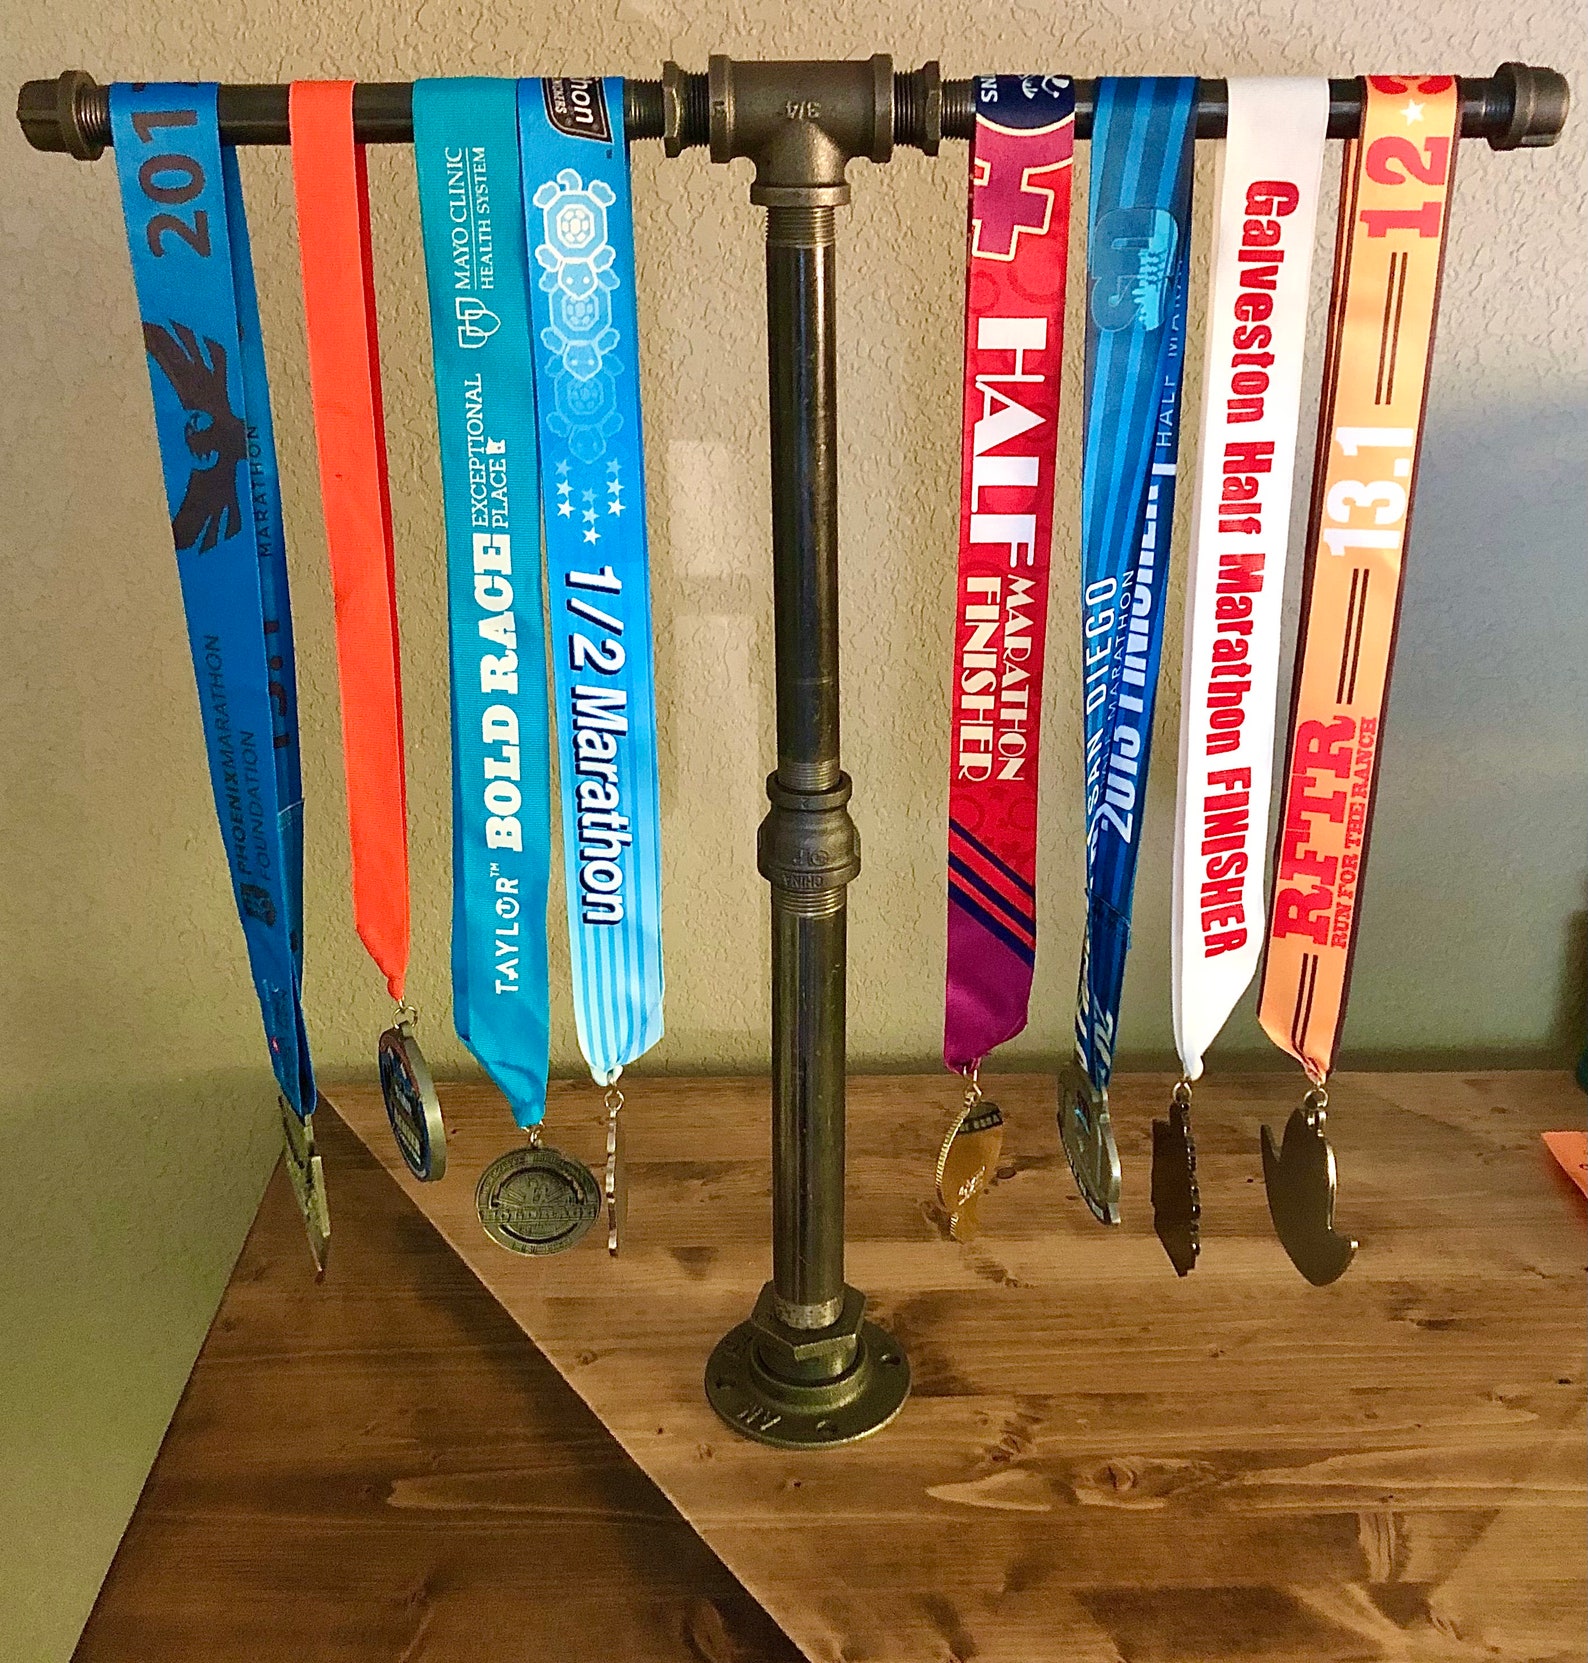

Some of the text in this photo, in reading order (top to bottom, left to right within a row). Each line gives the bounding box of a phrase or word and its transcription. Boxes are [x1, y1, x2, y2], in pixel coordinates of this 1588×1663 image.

[133, 82, 211, 258] 201
[444, 147, 471, 290] MAYO CLINIC
[472, 146, 495, 290] HEALTH SYSTEM
[1360, 135, 1450, 239] 12
[247, 425, 273, 559] MARATHON
[462, 373, 489, 528] EXCEPTIONAL
[489, 459, 509, 529] PLACE
[969, 318, 1047, 567] HALF
[1322, 426, 1414, 557] 13.1
[473, 533, 516, 696] RACE
[1107, 570, 1134, 719] MARATHON
[1200, 180, 1300, 958] Galveston Half Marathon FINISHER
[565, 566, 632, 927] 1/2 Marathon
[957, 576, 1001, 783] FINISHER
[996, 575, 1035, 780] MARATHON
[1085, 577, 1118, 815] SAN DIEGO
[240, 729, 272, 881] FOUNDATION
[483, 704, 523, 853] BOLD
[1274, 715, 1356, 946] RFTR
[1332, 716, 1378, 949] RUN FOR THE RANCH
